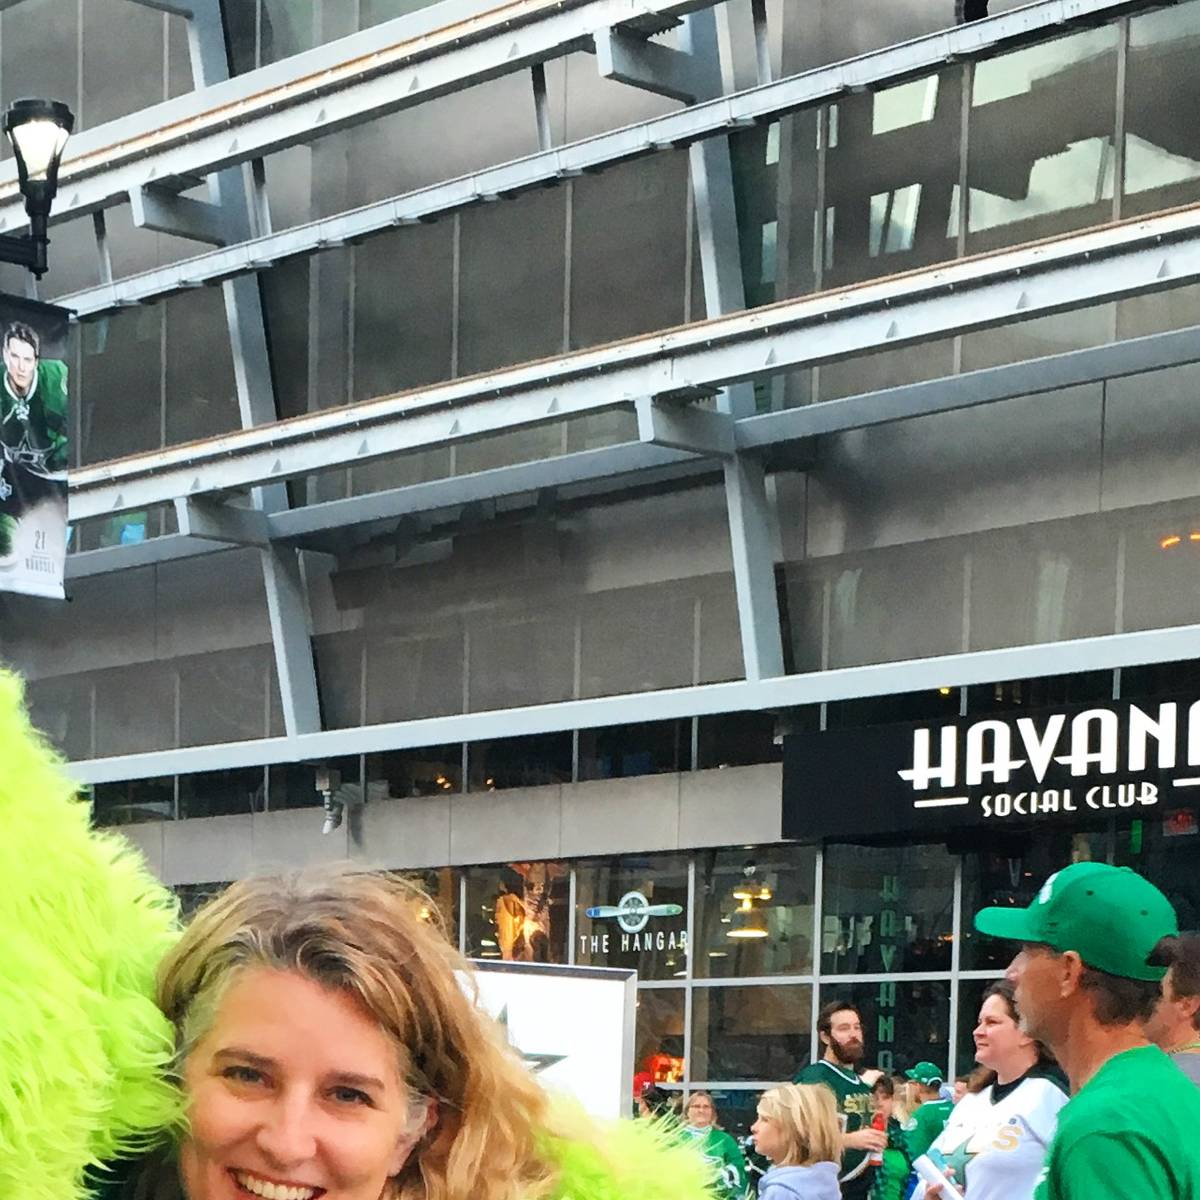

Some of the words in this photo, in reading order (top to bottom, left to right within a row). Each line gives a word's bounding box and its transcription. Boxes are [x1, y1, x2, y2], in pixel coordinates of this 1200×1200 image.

[981, 789, 1077, 818] SOCIAL
[1086, 782, 1159, 809] CLUB
[580, 934, 609, 954] THE
[621, 930, 689, 952] HANGAR
